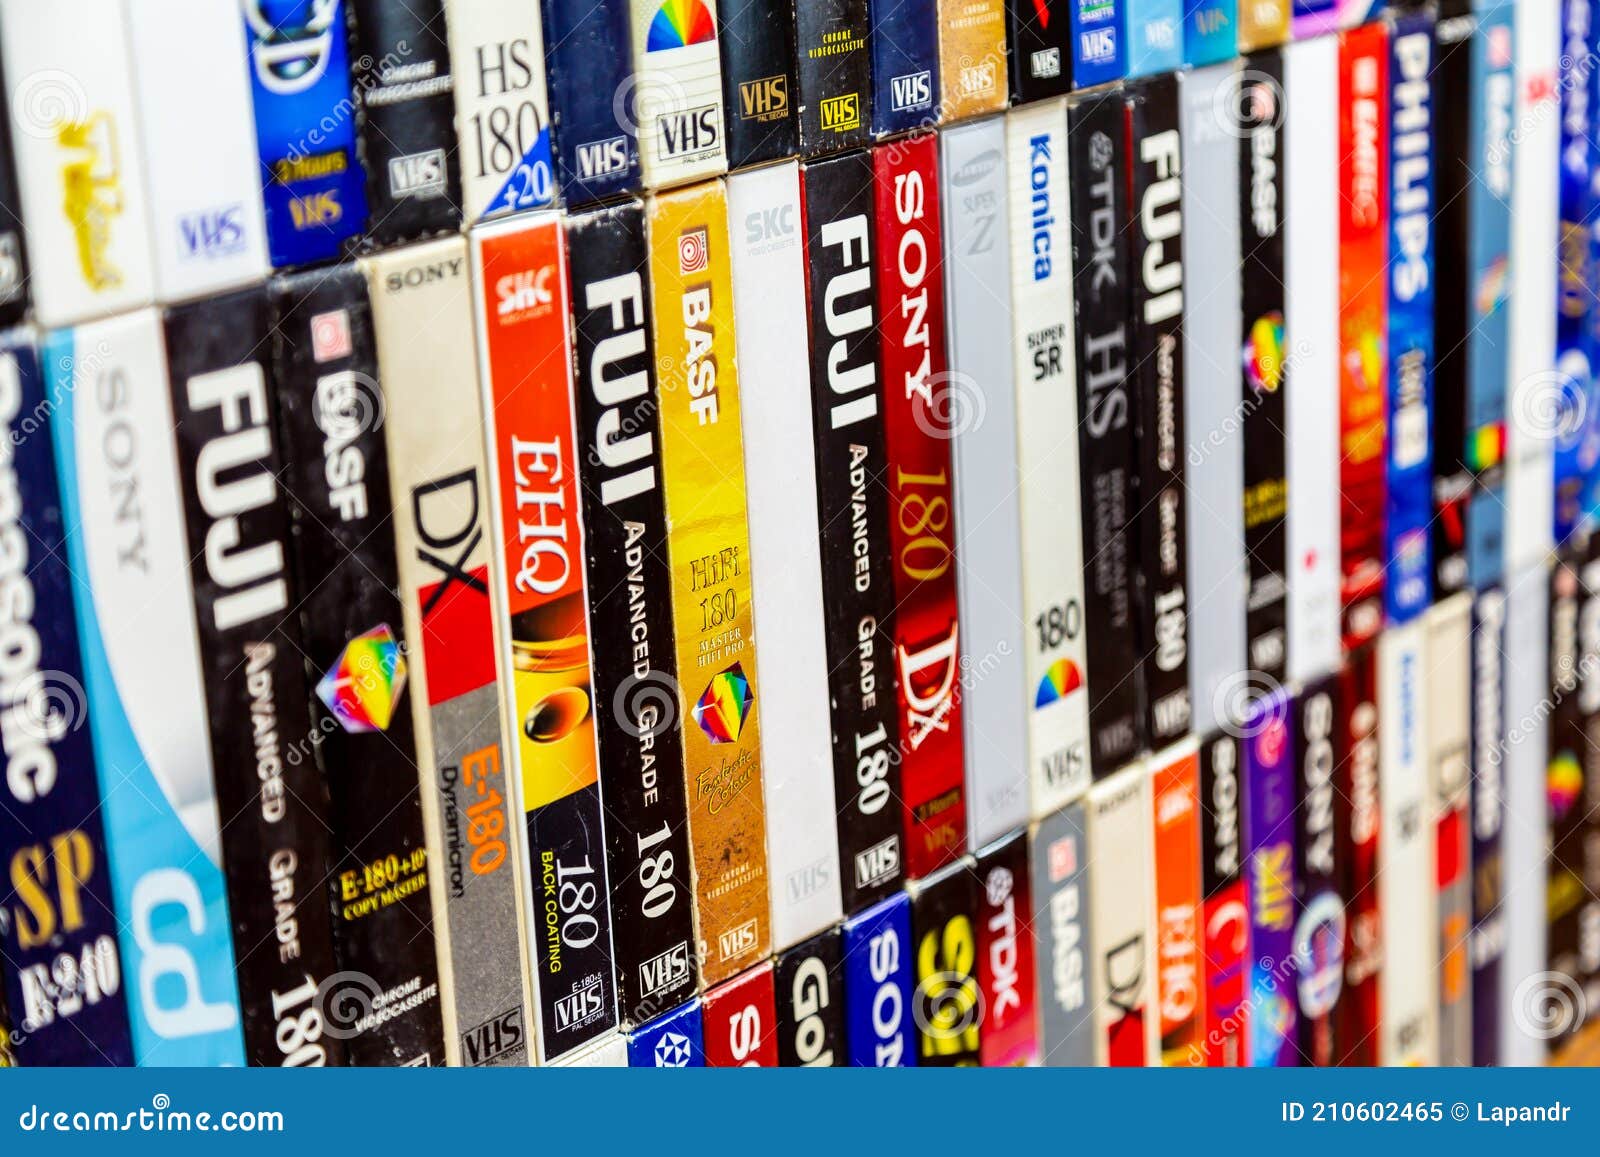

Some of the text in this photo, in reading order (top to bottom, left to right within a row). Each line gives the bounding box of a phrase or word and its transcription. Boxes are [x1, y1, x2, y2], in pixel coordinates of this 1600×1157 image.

[809, 39, 863, 58] VIDEOCASSETTE
[823, 30, 850, 43] CHROME
[475, 39, 531, 96] HS
[894, 74, 929, 107] VHS
[741, 77, 785, 115] VHS
[823, 98, 855, 125] VHS
[470, 101, 541, 178] 180
[661, 108, 716, 154] VHS
[504, 161, 550, 210] +20
[580, 139, 625, 178] VHS
[1250, 124, 1276, 238] BASF
[1393, 32, 1430, 301] PHILIPS
[180, 205, 242, 251] VHS
[745, 204, 794, 244] SKC
[967, 214, 997, 256] Z
[1030, 134, 1056, 282] Konica
[1089, 166, 1117, 290] TDK
[1141, 130, 1183, 324] FUJI
[385, 257, 463, 294] SONY
[496, 264, 557, 315] SKC
[895, 170, 932, 408] SONY
[682, 287, 720, 426] BASF
[1028, 324, 1065, 349] SUPER
[1034, 345, 1061, 381] SR
[1085, 323, 1128, 439] HS
[97, 368, 151, 576] SONY
[317, 371, 368, 521] BASF
[511, 435, 571, 594] EHQ
[821, 214, 890, 816] FUJI ADVANCED GRADE 180
[897, 464, 950, 580] 180
[411, 467, 488, 619] DX
[690, 546, 741, 592] HiFi
[585, 271, 676, 918] FUJI ADVANCED GRADE 180
[700, 588, 737, 632] 180
[700, 627, 742, 654] MASTER
[1036, 598, 1081, 652] 180
[1154, 583, 1186, 672] 180
[187, 361, 289, 631] FUJI
[244, 641, 287, 824] ADVANCED
[269, 849, 300, 965] GRADE
[697, 640, 745, 668] HIFI PRO
[899, 620, 959, 751] DX
[1043, 746, 1082, 787] VHS
[1304, 690, 1335, 874] SONY
[440, 766, 466, 899] Dynamicron
[461, 742, 508, 877] E-180
[1212, 737, 1240, 876] SONY
[10, 829, 95, 951] SP
[707, 866, 763, 900] VIDEOCASSETTE
[721, 861, 750, 883] CHROME
[788, 860, 830, 902] VHS
[857, 842, 898, 884] VHS
[344, 872, 426, 921] COPY MASTER
[541, 850, 562, 974] BACK COATING
[556, 854, 600, 949] 180
[722, 922, 754, 956] VHS
[989, 894, 1021, 1029] TDK
[1051, 884, 1085, 1012] BASF
[1160, 903, 1198, 1021] EHQ
[371, 976, 421, 1010] CHROME
[642, 945, 686, 992] VHS
[355, 983, 437, 1032] VIDEOCASSETTE
[557, 983, 601, 1027] VHS
[571, 1010, 605, 1033] PAL SECAM
[465, 1010, 521, 1065] VHS
